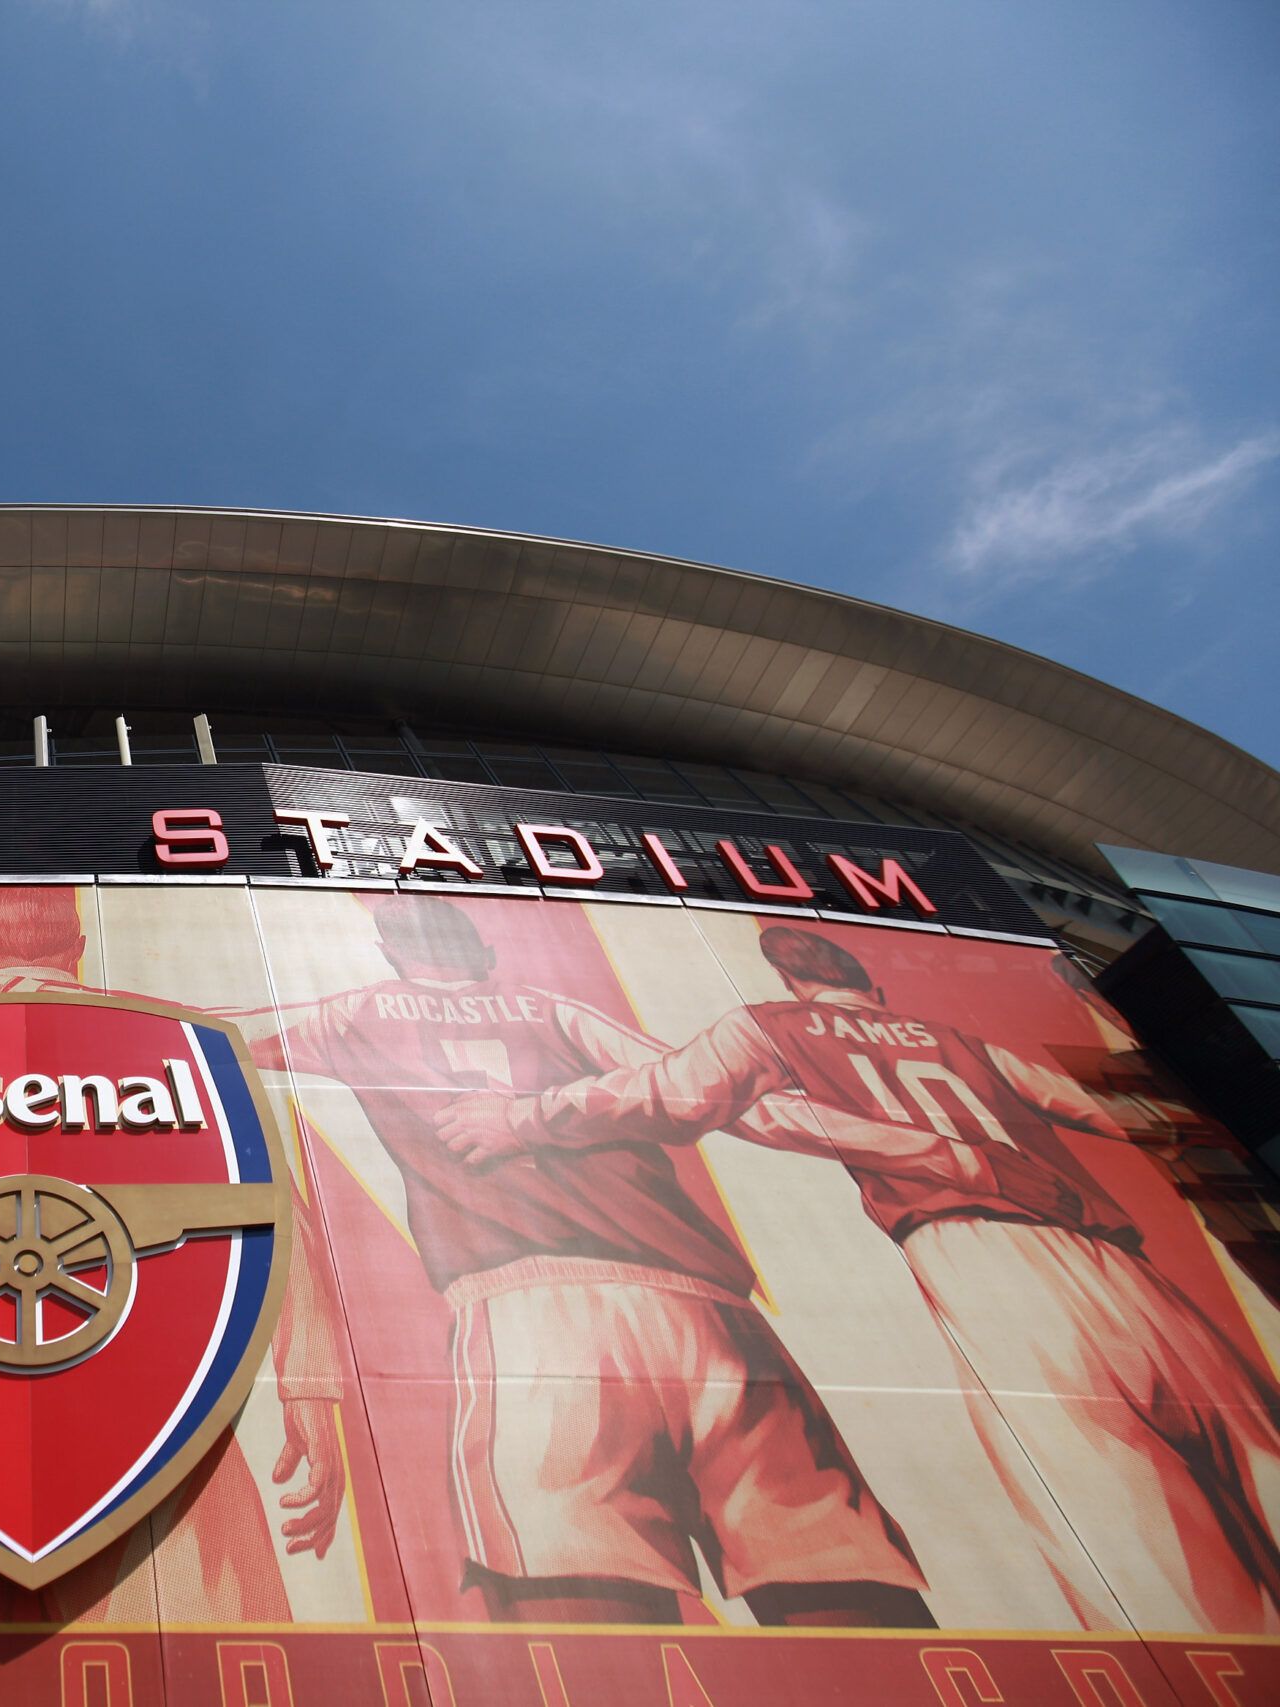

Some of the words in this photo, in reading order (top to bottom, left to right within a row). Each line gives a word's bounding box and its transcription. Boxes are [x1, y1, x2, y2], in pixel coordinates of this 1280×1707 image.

[152, 809, 937, 916] STADIUM
[375, 993, 545, 1025] ROCASTLE
[805, 1011, 939, 1048] JAMES
[847, 1053, 1021, 1160] 10
